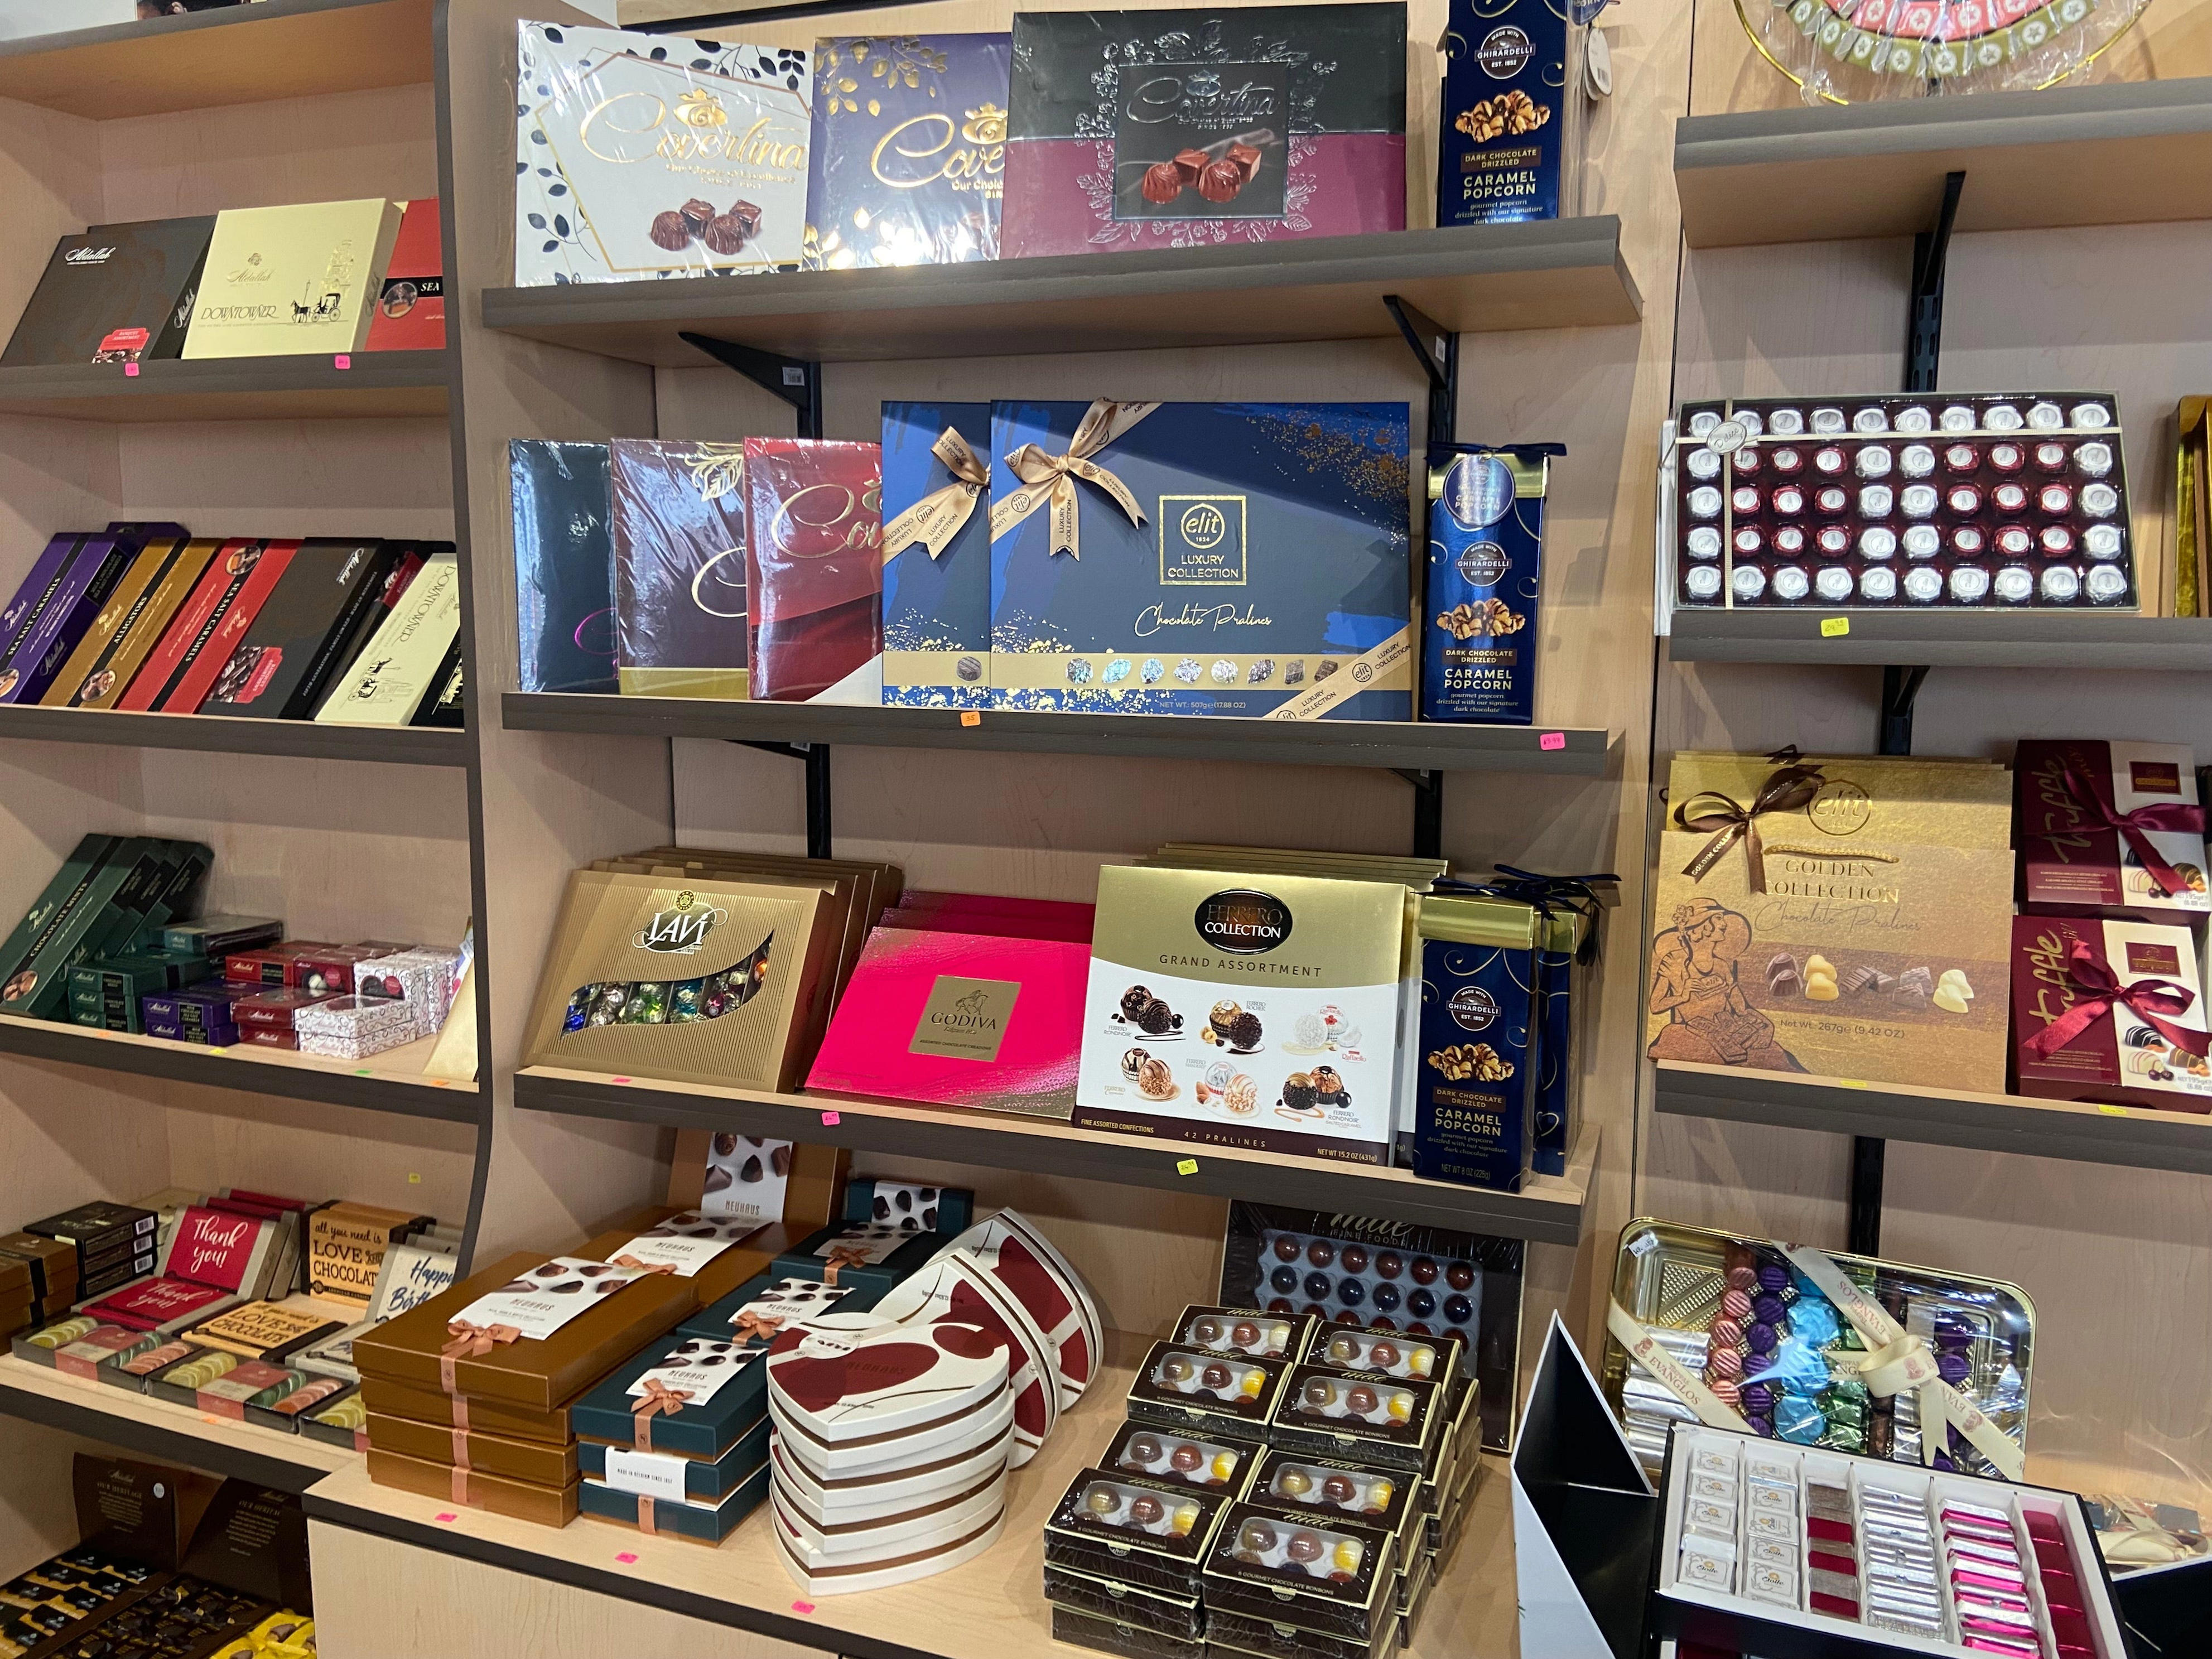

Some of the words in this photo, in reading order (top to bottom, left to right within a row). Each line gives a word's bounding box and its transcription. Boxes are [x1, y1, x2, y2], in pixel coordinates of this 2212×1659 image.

[1491, 30, 1506, 41] MADE
[1507, 30, 1519, 38] WITH
[1477, 46, 1533, 59] GHIRARDELLI
[1465, 153, 1486, 162] DARK
[1489, 148, 1537, 160] CHOCOLATE
[1481, 158, 1520, 168] DRIZZLED
[1464, 170, 1536, 187] CARAMEL
[1463, 183, 1536, 200] POPCORN
[1455, 210, 1480, 219] drizzled
[1481, 209, 1496, 217] with
[1510, 205, 1543, 215] signature
[1470, 201, 1498, 210] gourmet
[1499, 199, 1527, 209] popcorn
[1473, 217, 1489, 225] dark
[1490, 216, 1522, 224] chocolate
[421, 282, 440, 292] SEA
[201, 304, 279, 321] DOWNTOWNER
[946, 436, 966, 457] LUXURY
[1100, 475, 1130, 507] COLLECTION
[1109, 478, 1128, 499] LUXURY
[928, 514, 947, 536] LUXURY
[929, 514, 958, 546] COLLECTION
[1185, 512, 1220, 534] elit
[892, 528, 913, 547] LUXURY
[1486, 544, 1497, 553] WITH
[1181, 554, 1224, 565] LUXURY
[1168, 568, 1239, 578] COLLECTION
[226, 583, 240, 597] SEA
[8, 641, 20, 655] SEA
[18, 621, 33, 642] SALT
[32, 577, 61, 619] CARAMELS
[214, 597, 230, 618] SALT
[114, 596, 148, 644] ALLIGATORS
[1134, 602, 1207, 637] Chocolate
[1203, 604, 1272, 632] Pralines
[185, 619, 216, 662] CARAMELS
[1375, 644, 1411, 670] COLLECTION
[1377, 642, 1400, 659] LUXURY
[1355, 665, 1370, 678] elit
[1444, 668, 1512, 679] CARAMEL
[1444, 679, 1512, 690] POPCORN
[1299, 692, 1336, 717] COLLECTION
[1302, 689, 1324, 706] LUXURY
[1786, 860, 1876, 878] GOLDEN
[1765, 880, 1900, 904] COLLECTION
[30, 908, 68, 957] CHOCOLATE
[66, 882, 88, 909] MINTS
[1207, 904, 1283, 926] FERRERO
[1755, 901, 1841, 932] Chocolate
[1845, 909, 1922, 932] Pralines
[1204, 922, 1281, 939] COLLECTION
[1159, 954, 1210, 968] GRAND
[1218, 960, 1322, 978] ASSORTMENT
[1476, 990, 1487, 999] WITH
[1449, 1003, 1498, 1014] GHIRARDELLI
[931, 1012, 996, 1030] GODIVA
[1884, 1028, 1905, 1039] OZ)
[1342, 1053, 1366, 1062] Raffaello
[1452, 1098, 1486, 1108] DRIZZLED
[1459, 1093, 1502, 1103] CHOCOLATE
[1435, 1108, 1501, 1126] CARAMEL
[1093, 1120, 1118, 1130] ASSORTED
[1119, 1124, 1154, 1134] CONFECTIONS
[1435, 1118, 1501, 1136] POPCORN
[1206, 1134, 1267, 1148] PRALINES
[1478, 1145, 1508, 1154] signature
[1338, 1150, 1351, 1159] 15.2
[1358, 1153, 1378, 1163] (431g)
[1442, 1164, 1451, 1173] NET
[725, 1200, 760, 1216] NEUHAUS
[193, 1215, 249, 1248] Thank
[315, 1221, 329, 1234] all
[330, 1227, 348, 1241] you
[350, 1229, 371, 1242] need
[373, 1232, 382, 1245] is
[1367, 1234, 1406, 1247] FOODS
[191, 1246, 228, 1274] you!
[313, 1239, 362, 1264] LOVE
[509, 1299, 555, 1311] NEUHAUS
[1840, 1281, 1885, 1335] EVANGLOS
[668, 1370, 707, 1381] NEUHAUS
[1650, 1357, 1700, 1405] EVANGLOS
[1185, 1400, 1213, 1410] CHOCOLATE
[1309, 1422, 1332, 1431] GOURMET
[1333, 1426, 1363, 1435] CHOCOLATE
[1082, 1527, 1107, 1539] GOURMET
[1108, 1533, 1139, 1545] CHOCOLATE
[1140, 1541, 1167, 1550] BONBONS
[1242, 1572, 1270, 1583] GOURMET
[1271, 1577, 1305, 1589] CHOCOLATE
[1305, 1584, 1334, 1595] BONBONS
